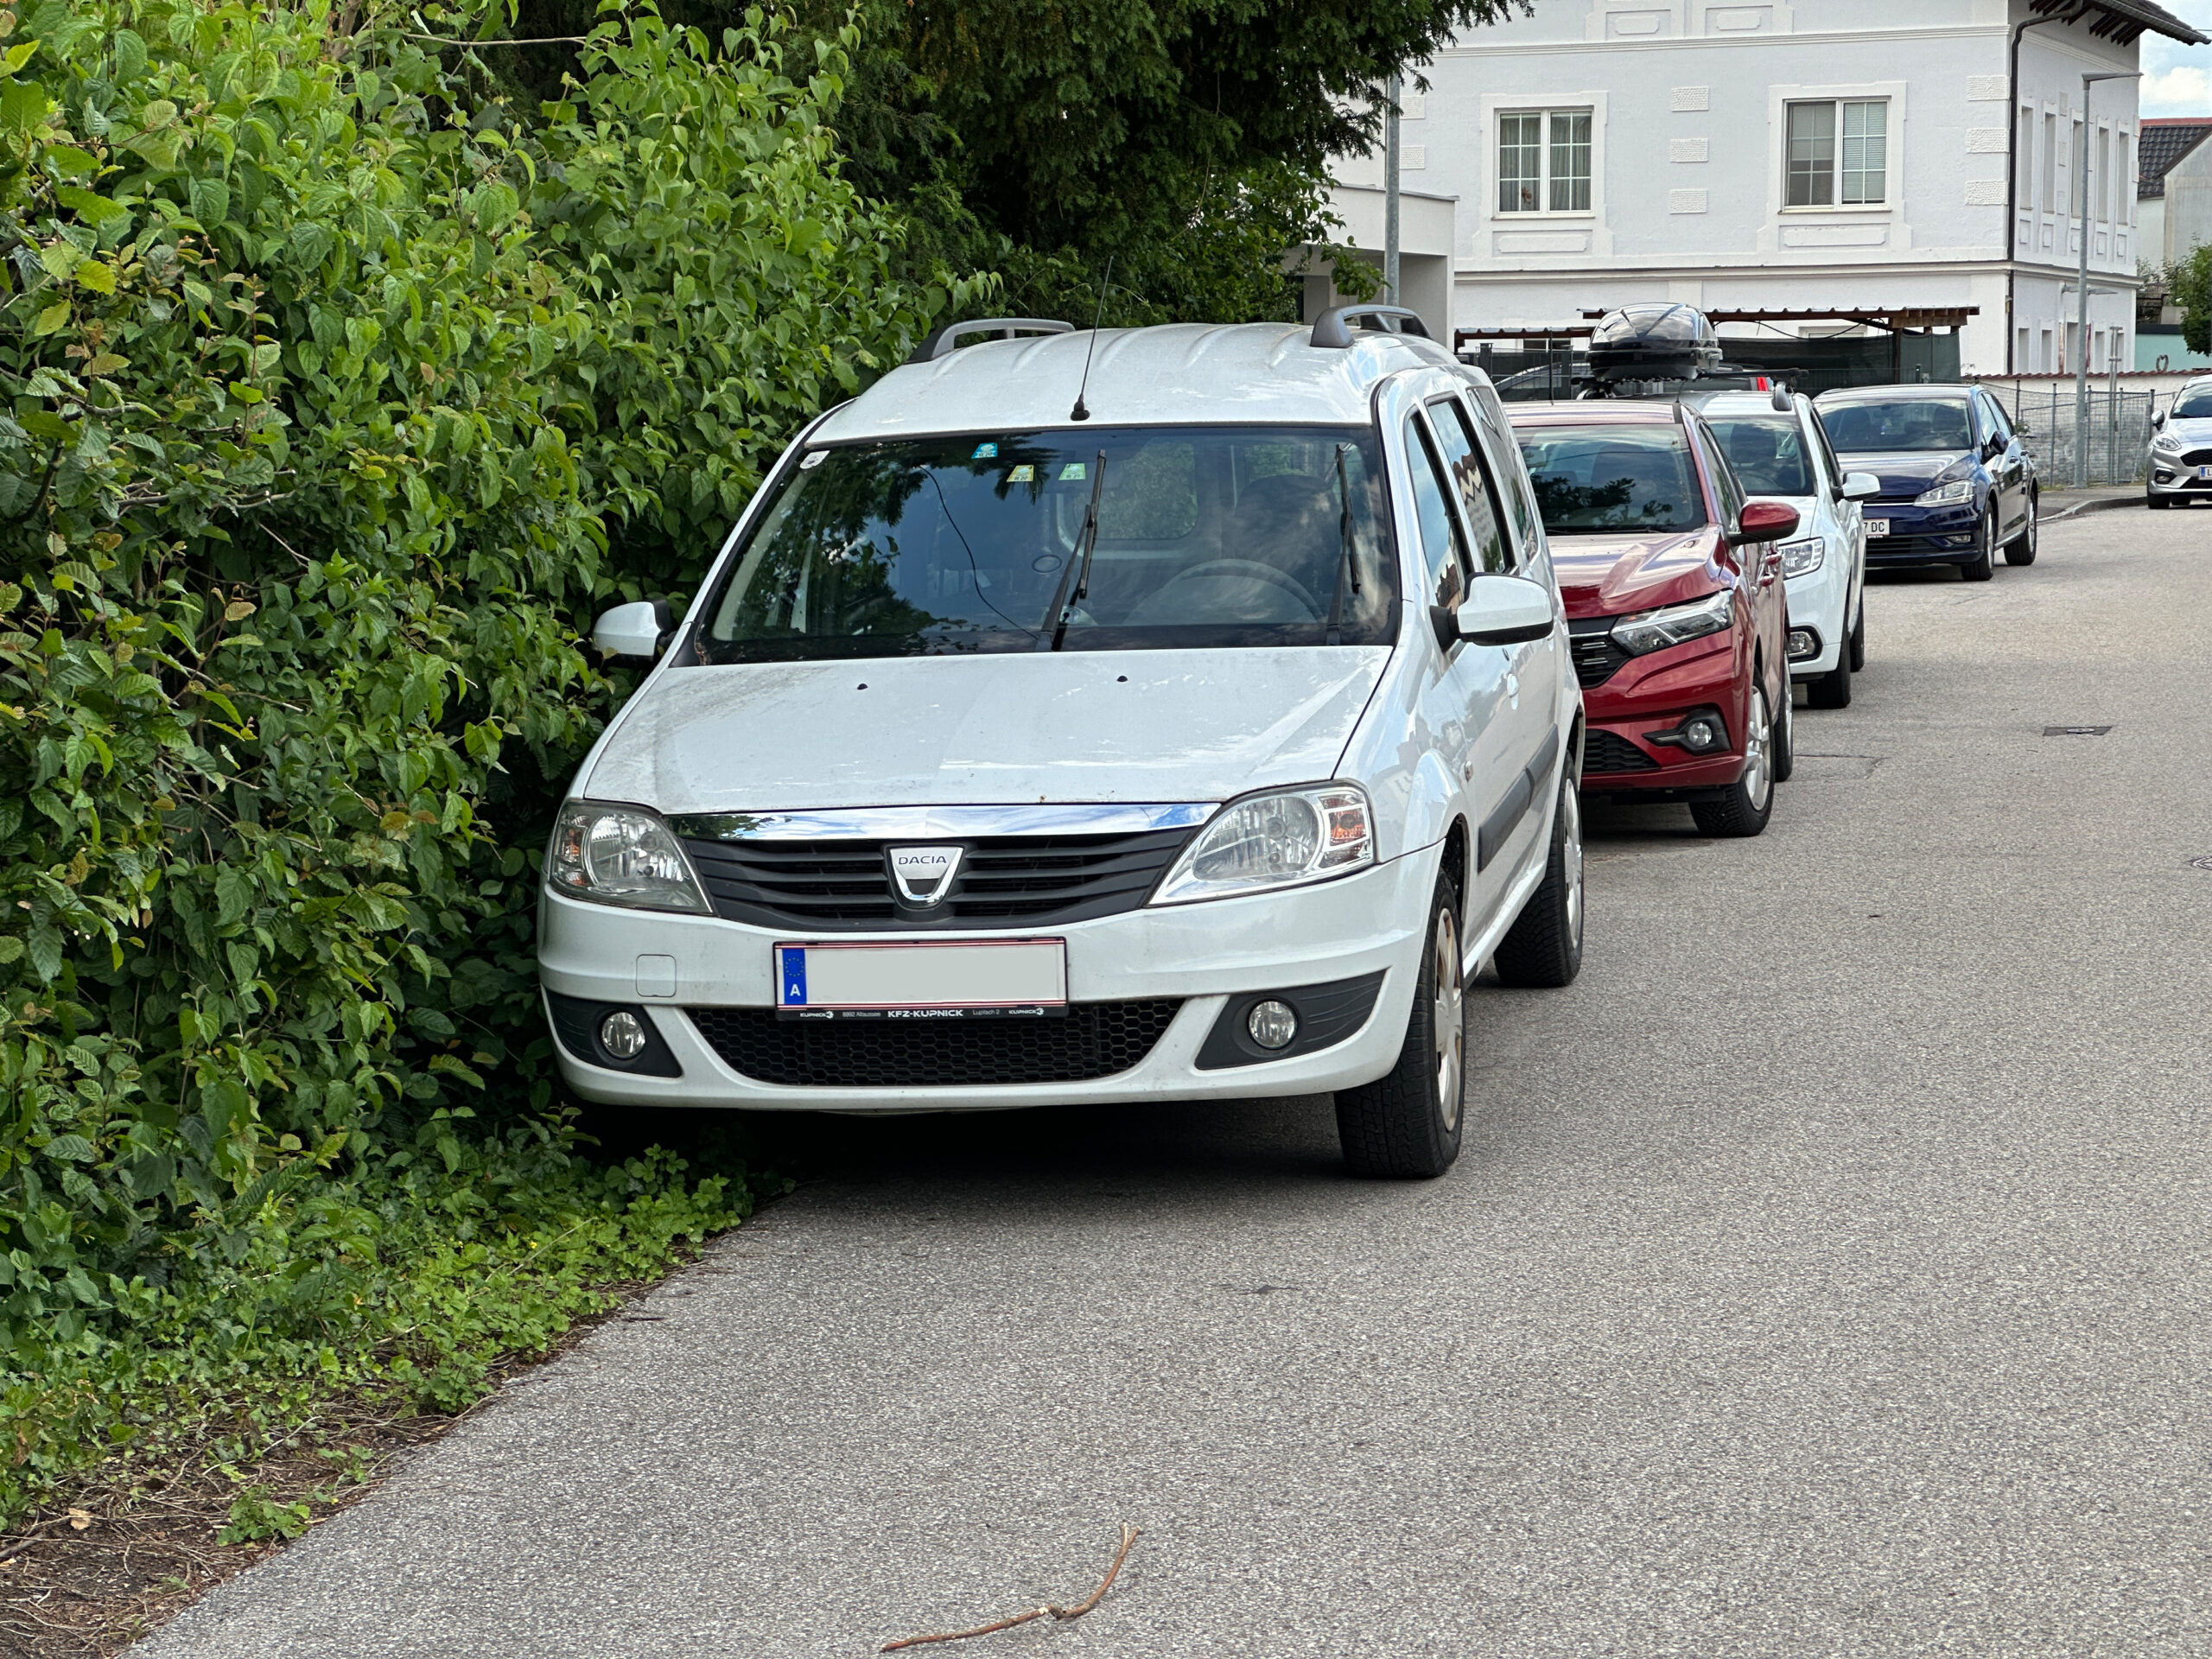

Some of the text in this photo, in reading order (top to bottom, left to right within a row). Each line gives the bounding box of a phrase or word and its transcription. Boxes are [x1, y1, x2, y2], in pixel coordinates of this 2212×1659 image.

[1871, 522, 1885, 532] DC
[899, 855, 947, 865] DACIA
[790, 983, 801, 996] A
[887, 1009, 964, 1018] KFZ-KUPNICK
